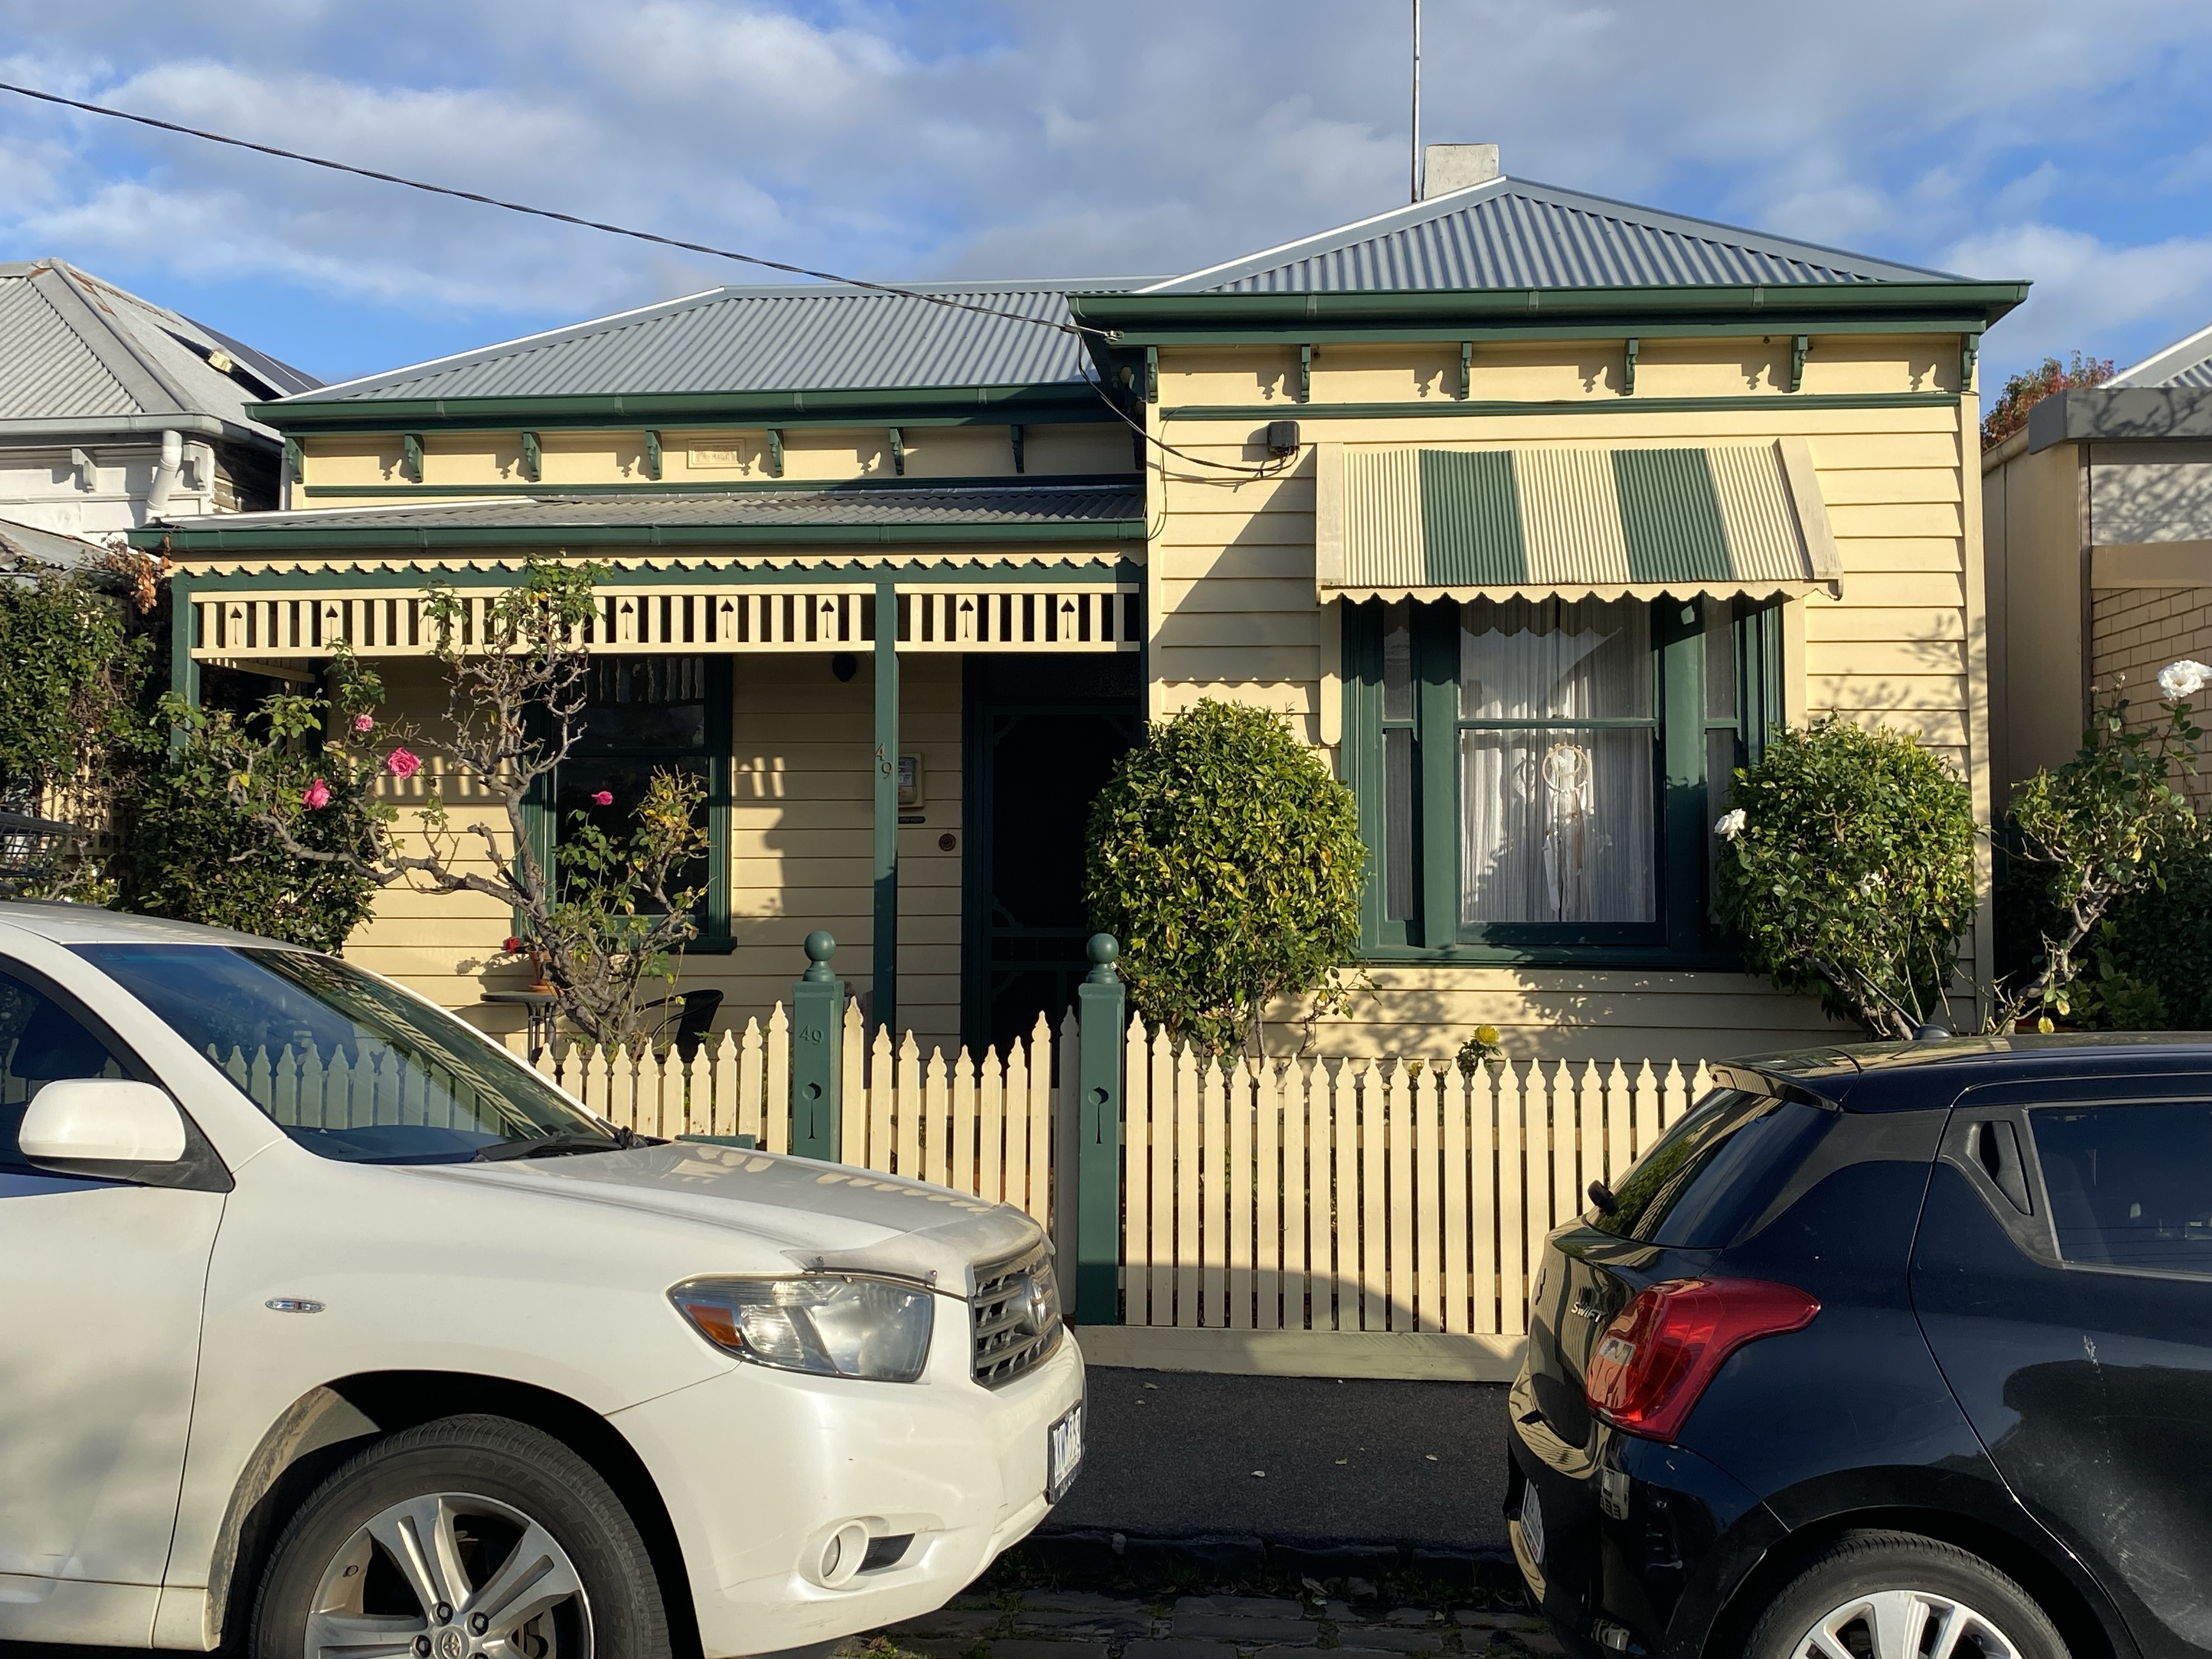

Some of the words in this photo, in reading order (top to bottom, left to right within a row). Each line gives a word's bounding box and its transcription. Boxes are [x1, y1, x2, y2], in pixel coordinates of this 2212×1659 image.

[875, 743, 893, 779] 49
[799, 1024, 823, 1045] 49
[461, 1455, 614, 1578] DUELER
